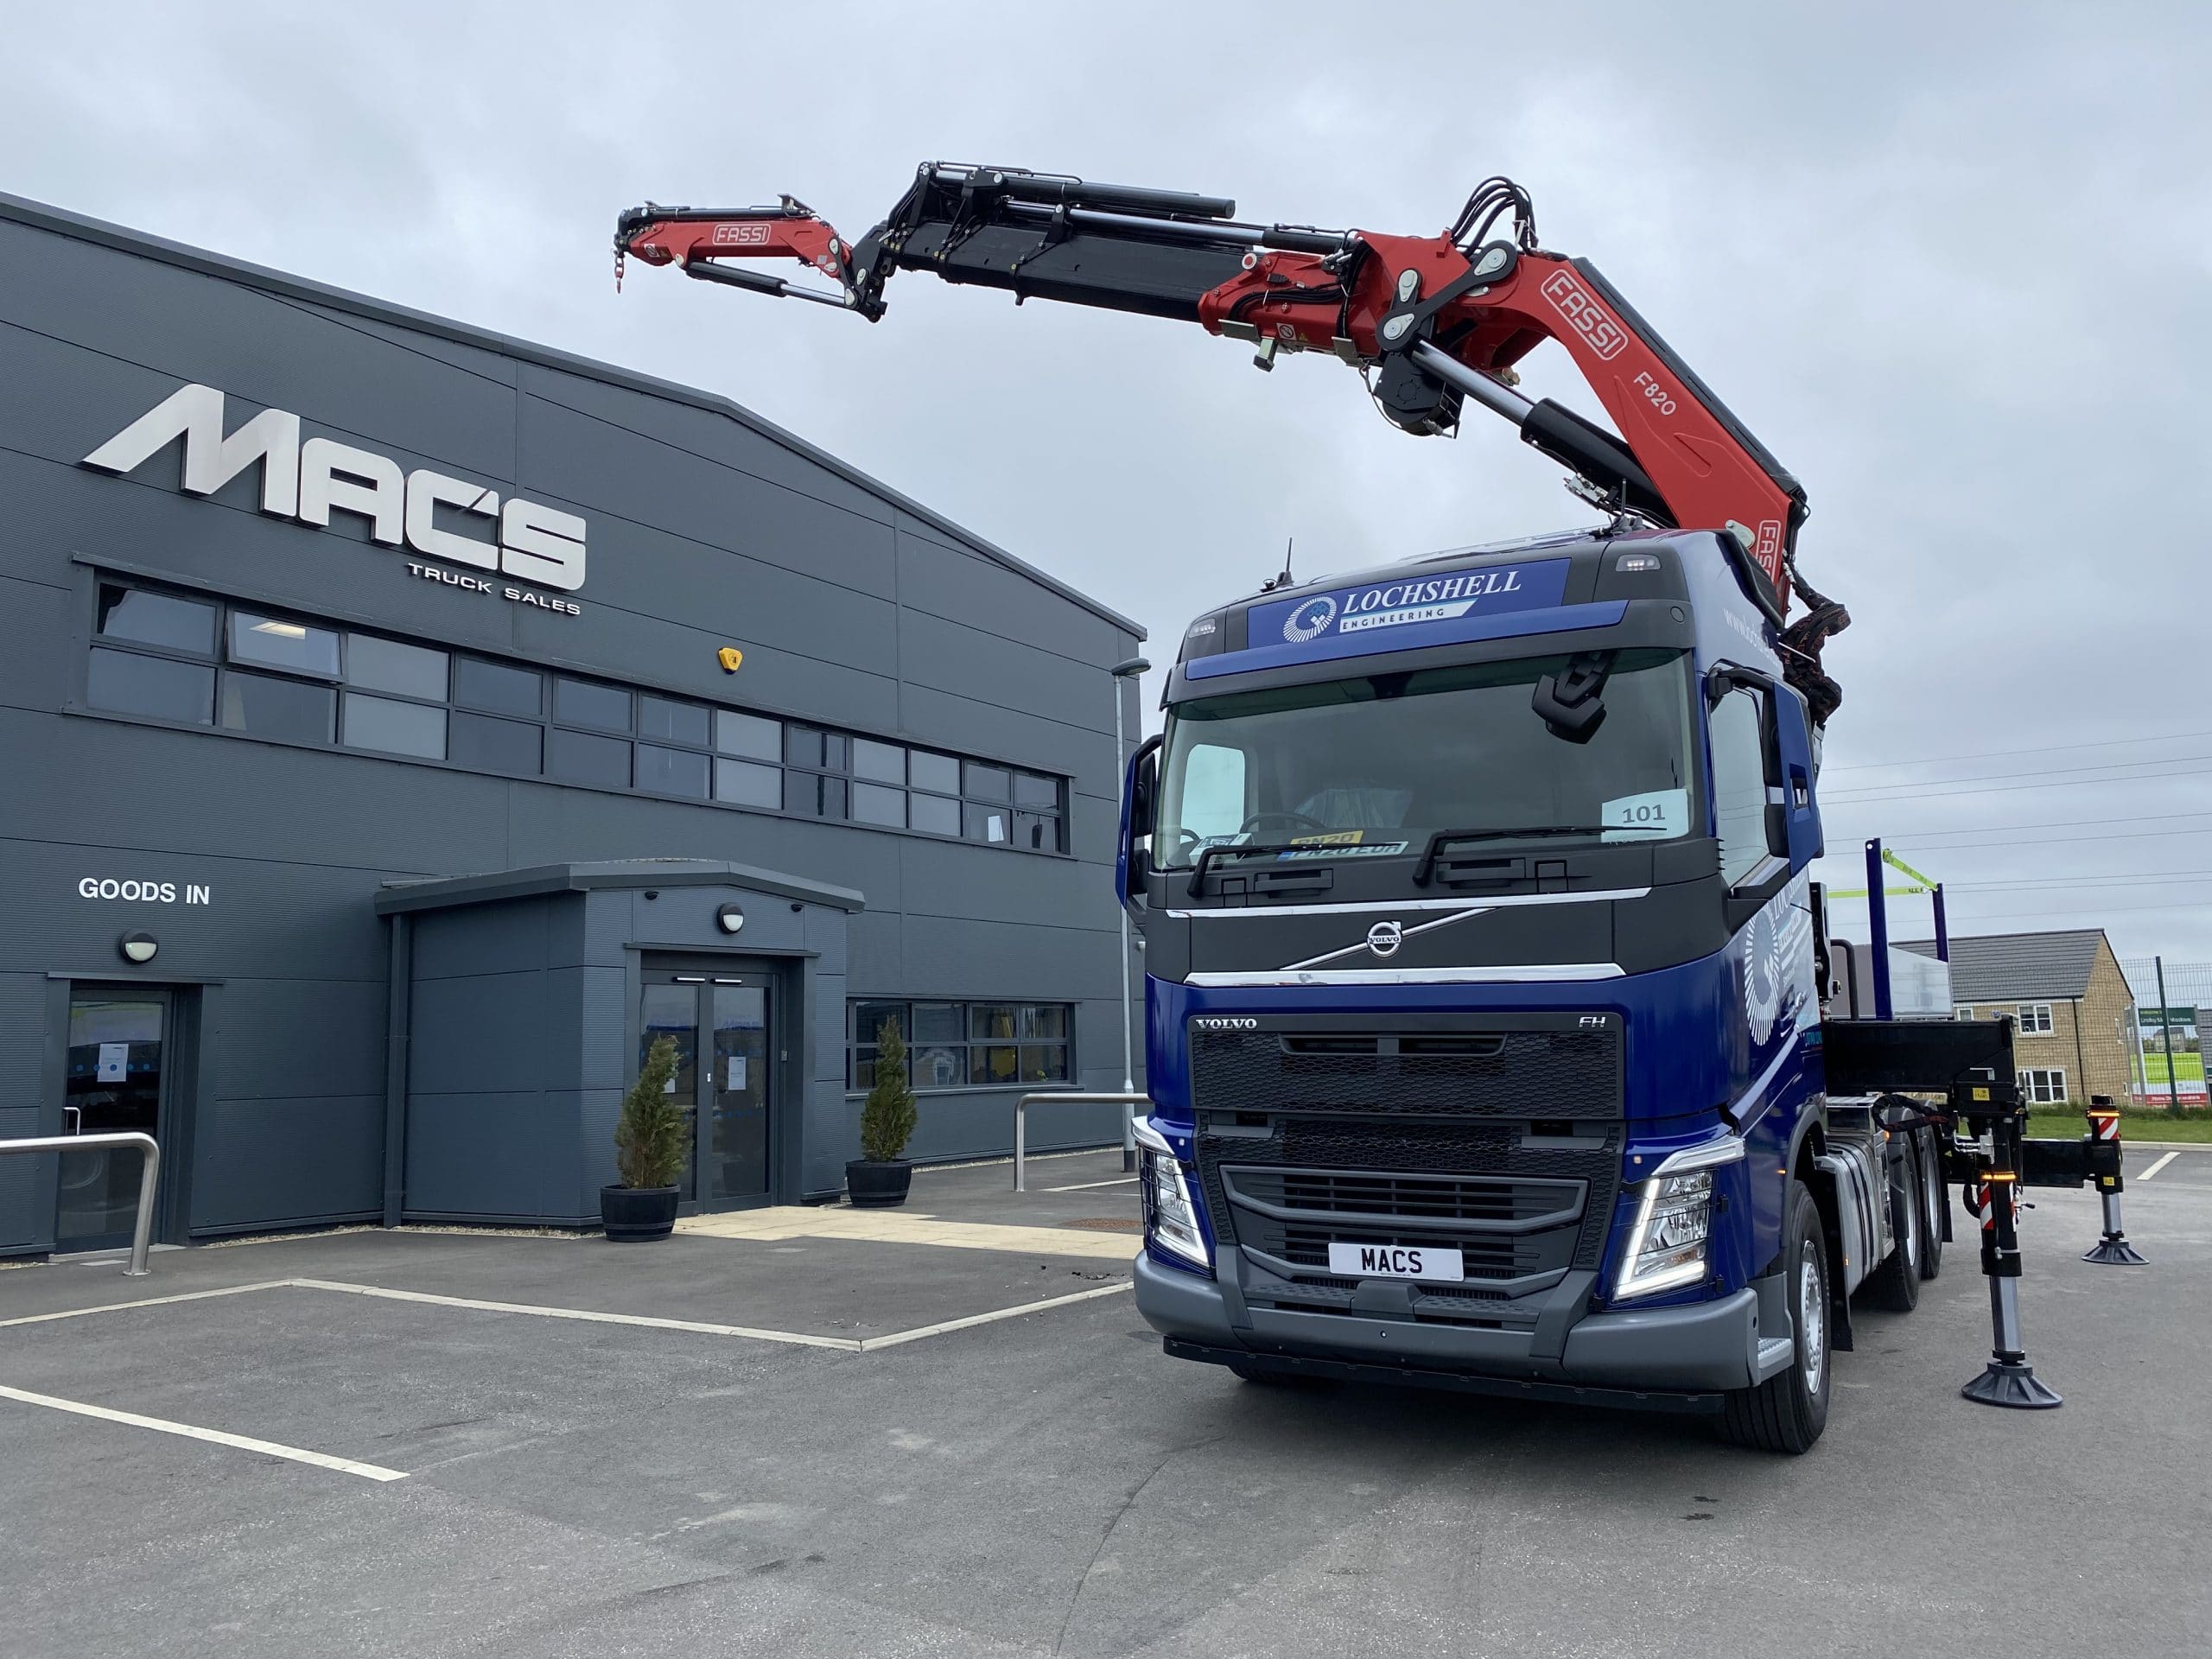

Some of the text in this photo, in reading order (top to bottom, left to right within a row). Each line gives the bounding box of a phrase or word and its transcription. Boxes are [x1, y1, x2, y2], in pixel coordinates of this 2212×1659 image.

[716, 226, 767, 242] FASSI
[1547, 276, 1622, 354] FASSI
[1632, 371, 1677, 416] F820
[407, 563, 582, 616] TRUCK SALES
[1341, 570, 1522, 614] LOCHSHELL
[1342, 607, 1445, 630] ENGINEERING
[1622, 804, 1666, 823] 101
[79, 877, 210, 905] GOODS IN
[1195, 1018, 1258, 1030] VOLVO
[1579, 1016, 1606, 1028] FH
[1361, 1248, 1423, 1274] MACS
